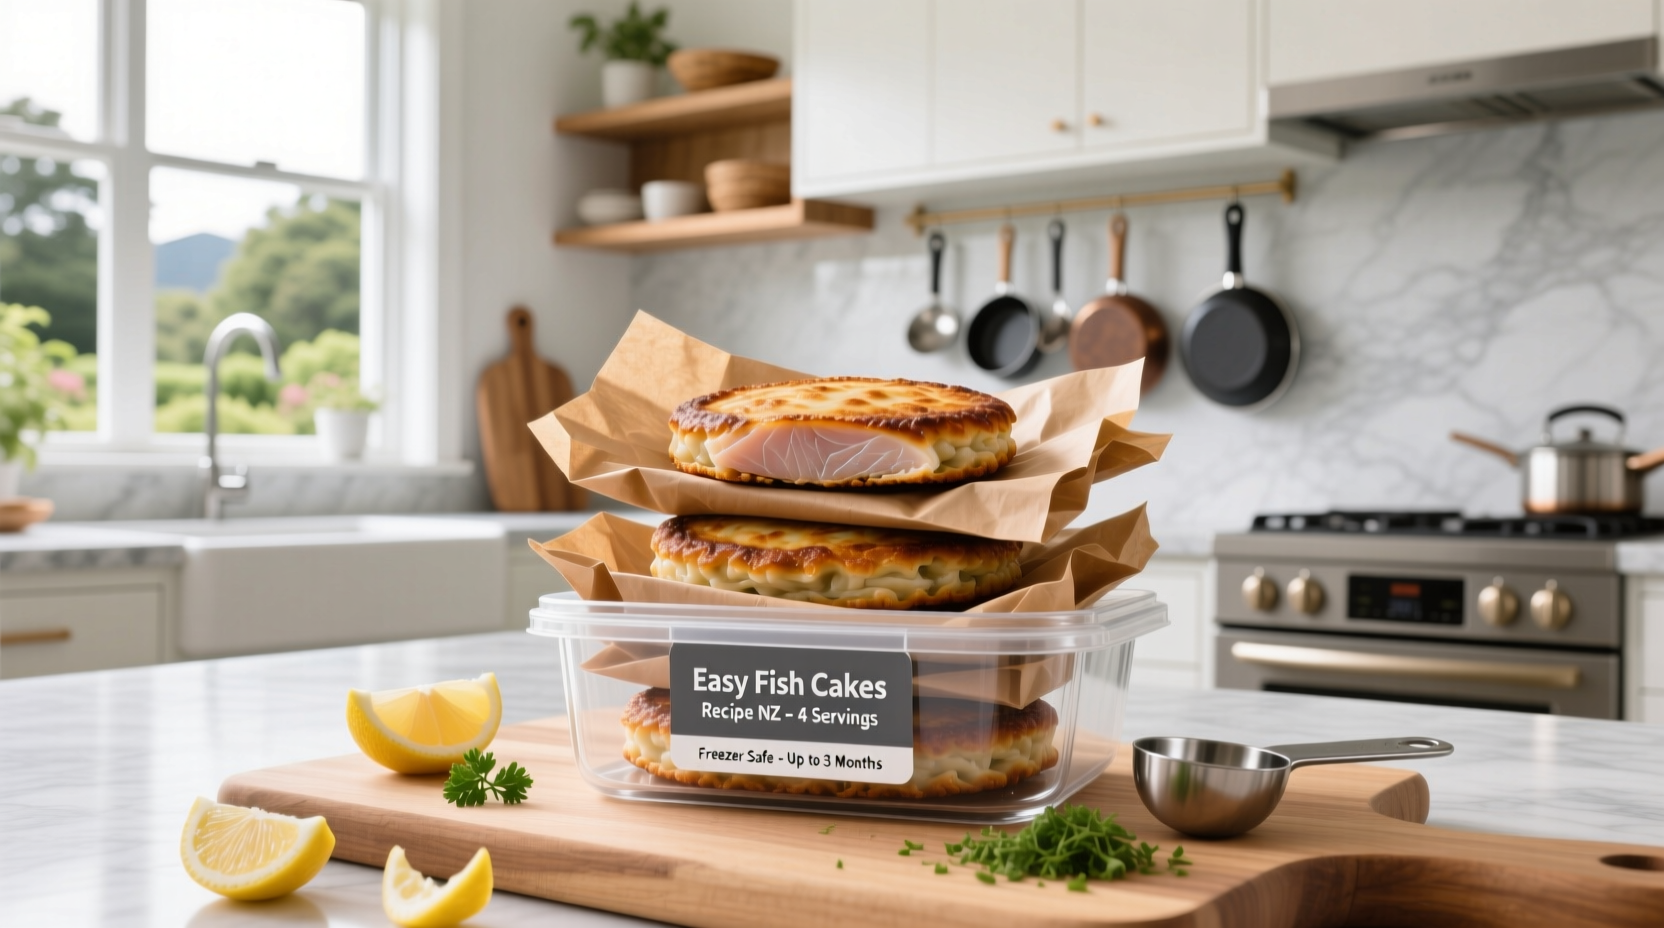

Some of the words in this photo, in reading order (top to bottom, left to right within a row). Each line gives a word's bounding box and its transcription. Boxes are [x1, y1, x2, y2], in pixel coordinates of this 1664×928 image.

[693, 667, 749, 700] Easy
[755, 669, 805, 696] Fish
[811, 672, 887, 700] Cakes
[702, 701, 754, 723] Recipe
[758, 704, 781, 722] NZ
[797, 706, 808, 723] 4
[812, 707, 878, 730] Servings
[698, 747, 745, 763] Freezer
[747, 750, 774, 764] Safe
[787, 752, 805, 769] Up
[808, 754, 821, 767] to
[823, 754, 831, 767] 3
[835, 755, 883, 770] Months
